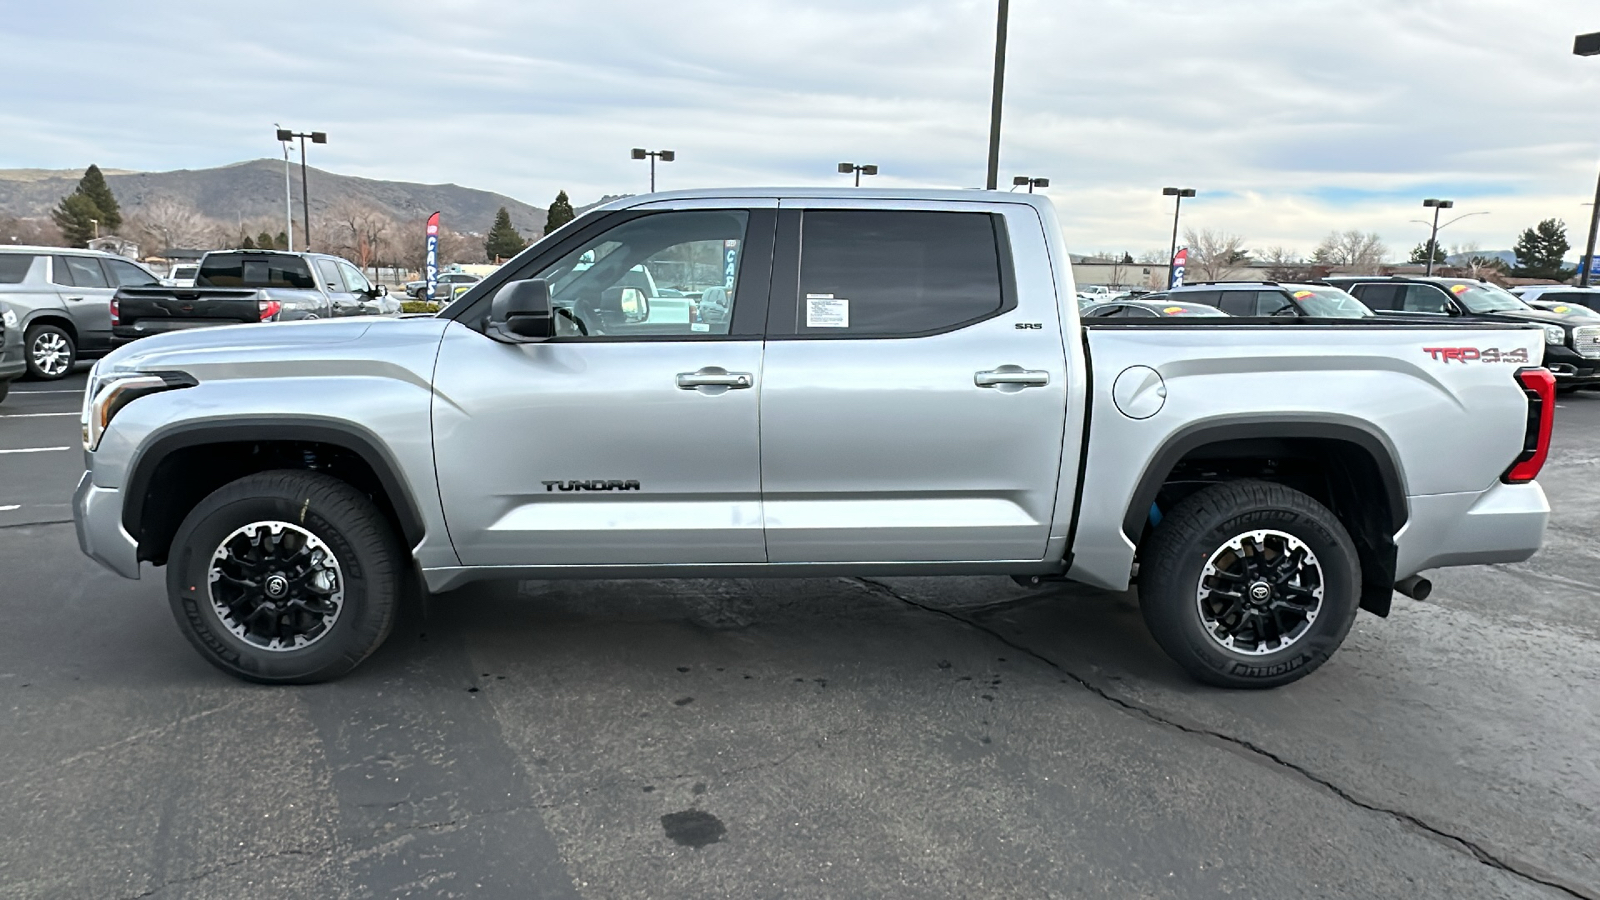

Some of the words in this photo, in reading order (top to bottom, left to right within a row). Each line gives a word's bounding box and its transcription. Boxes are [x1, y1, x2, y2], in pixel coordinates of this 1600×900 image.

[427, 236, 437, 295] CARS
[1422, 347, 1481, 364] TRD
[541, 479, 641, 491] TUNDRA
[1221, 510, 1297, 532] MICHELIN
[1232, 656, 1304, 677] MICHELIN
